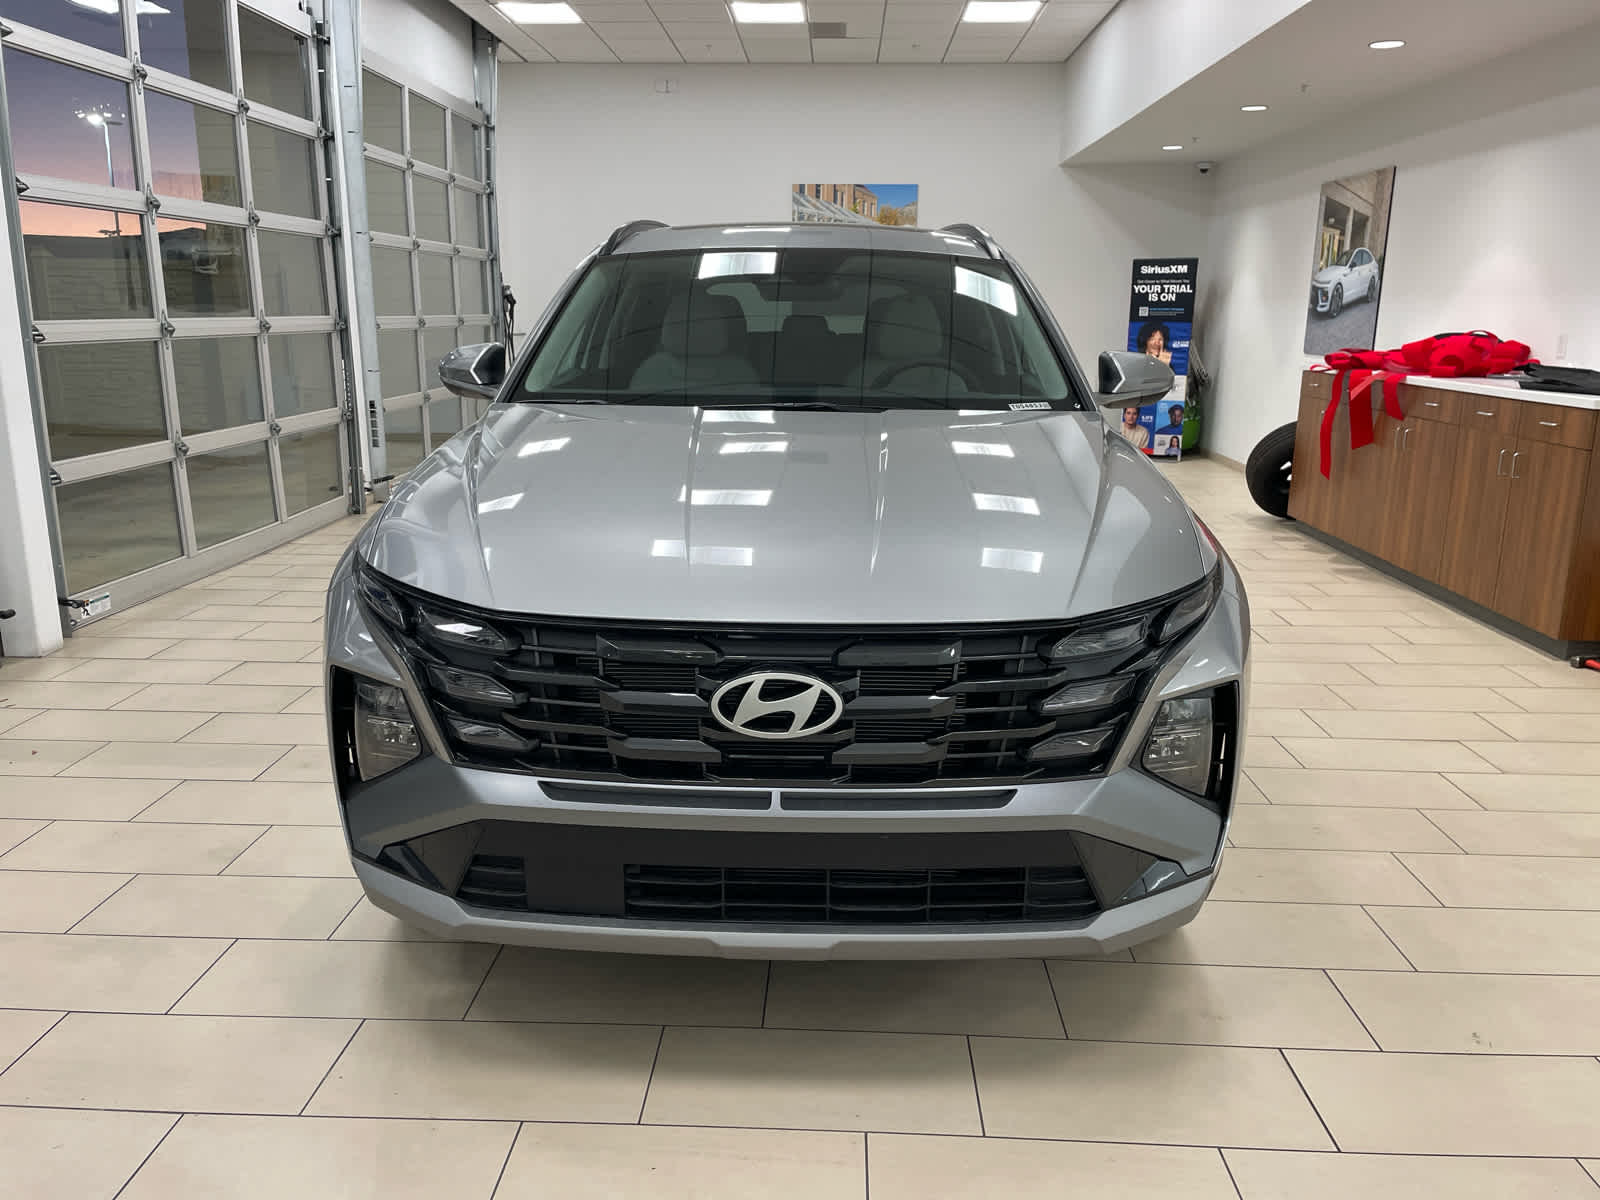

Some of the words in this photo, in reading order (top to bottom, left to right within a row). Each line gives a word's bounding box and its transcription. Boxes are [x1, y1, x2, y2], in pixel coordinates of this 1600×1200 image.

[1140, 265, 1188, 274] SiriusXM
[1133, 285, 1161, 293] YOUR
[1163, 285, 1193, 293] TRIAL
[1148, 293, 1158, 302] IS
[1160, 293, 1176, 302] ON
